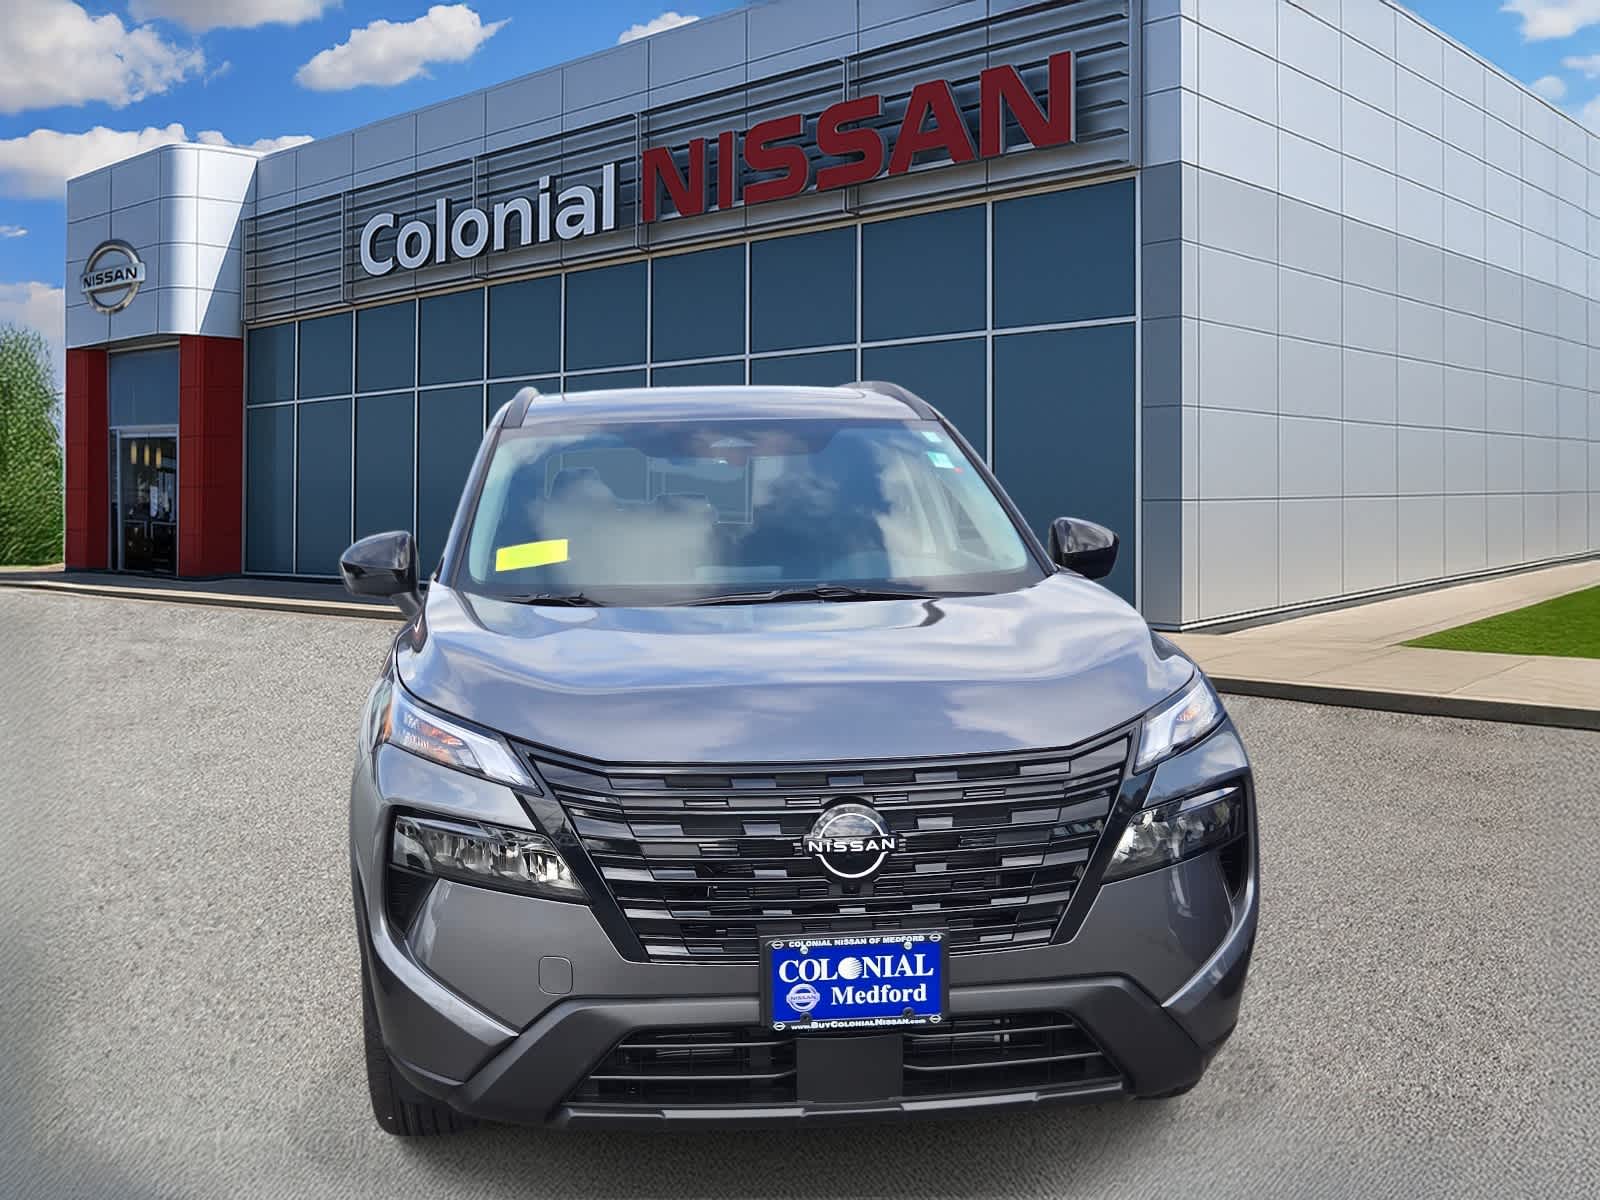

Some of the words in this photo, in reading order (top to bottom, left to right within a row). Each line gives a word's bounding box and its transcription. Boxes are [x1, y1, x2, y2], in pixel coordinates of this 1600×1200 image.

[359, 162, 617, 277] Colonial
[642, 51, 1077, 223] NISSAN
[83, 266, 137, 288] NISSAN
[808, 838, 895, 853] NISSAN
[788, 939, 832, 948] COLONIAL
[834, 937, 867, 946] NISSAN
[868, 937, 880, 945] OF
[882, 935, 925, 944] MEDFORD
[779, 953, 934, 983] COLONIAL
[831, 983, 928, 1006] Medford
